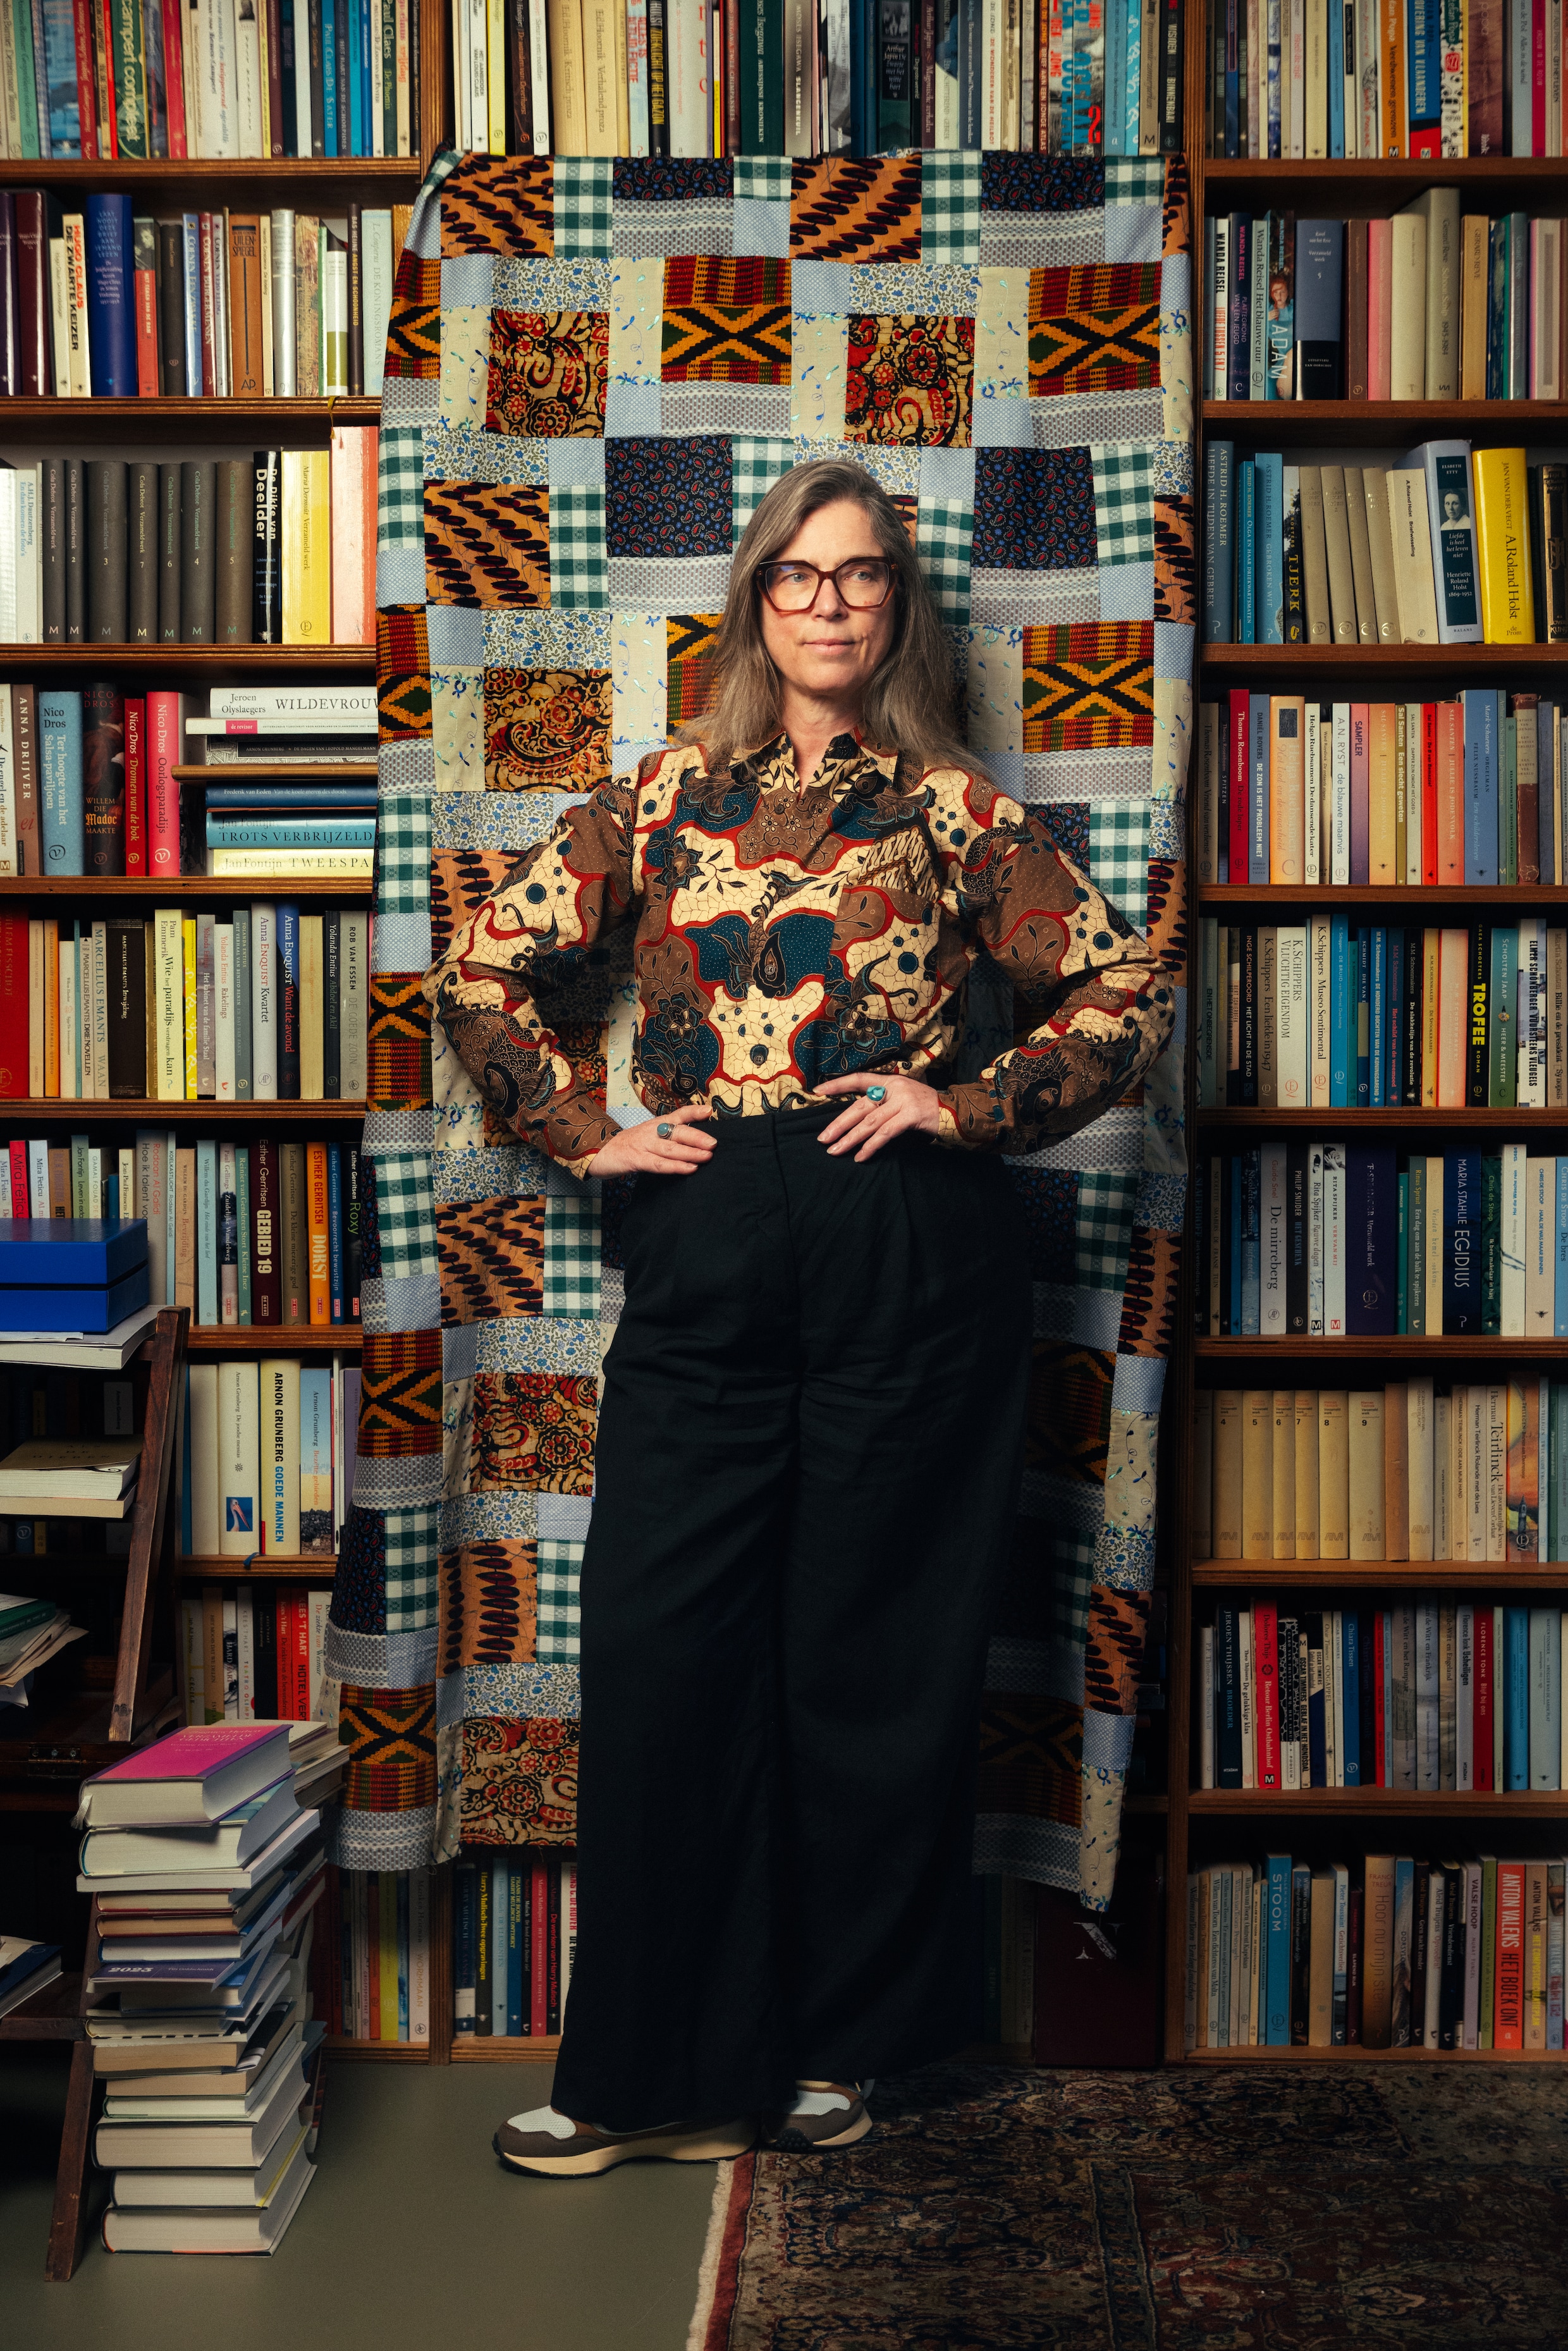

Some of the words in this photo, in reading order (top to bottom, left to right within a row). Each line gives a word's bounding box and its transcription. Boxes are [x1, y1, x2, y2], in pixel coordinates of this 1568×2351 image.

[650, 28, 663, 70] ZOEKLICHT
[651, 71, 663, 82] OP
[651, 83, 664, 97] HET
[121, 66, 140, 141] compleet
[652, 99, 665, 125] GAZON
[1074, 52, 1091, 144] OCEAAN
[66, 226, 73, 242] DE
[73, 225, 82, 261] HUGO
[67, 245, 75, 301] ZWARTE
[75, 266, 83, 309] CLAUS
[352, 276, 358, 284] EN
[70, 305, 78, 350] KEIZER
[1271, 324, 1288, 379] ADAM
[256, 468, 268, 540] Deelder
[1208, 488, 1215, 500] IN
[1220, 490, 1227, 500] H.
[1289, 554, 1300, 611] TJERK
[44, 708, 64, 716] Nico
[221, 704, 266, 715] Olyslaegers
[230, 693, 257, 703] Jeroen
[20, 697, 28, 734] ANNA
[44, 719, 66, 728] Dros
[158, 704, 167, 727] Nico
[57, 735, 66, 751] Ter
[158, 730, 167, 753] Dros
[1337, 742, 1345, 766] RYST
[1354, 721, 1363, 756] SAMPLER
[21, 741, 31, 799] DRIJVER
[44, 735, 54, 809] Salsa-paviljoen
[55, 753, 67, 787] hoogte
[1256, 763, 1263, 771] DE
[1337, 773, 1345, 785] de
[58, 789, 66, 807] van
[156, 758, 168, 834] Oorlogsparadijs
[1337, 787, 1345, 818] blauwe
[58, 809, 68, 825] het
[85, 811, 117, 826] Madoc
[1337, 820, 1345, 854] maanvis
[260, 917, 269, 941] Anna
[164, 957, 174, 976] Wie
[260, 943, 269, 986] ENQUIST
[163, 987, 175, 1026] paradijs
[260, 988, 269, 1023] Kwartet
[1472, 983, 1486, 1045] TROFEE
[166, 1057, 175, 1075] kan
[152, 1143, 161, 1177] Rodaan
[259, 1139, 268, 1165] Esther
[313, 1151, 322, 1179] ESTHER
[153, 1180, 160, 1188] Al
[259, 1167, 269, 1206] Gerritsen
[1457, 1159, 1467, 1188] MARIA
[314, 1182, 324, 1224] GERRITSEN
[1270, 1206, 1282, 1224] De
[1457, 1191, 1467, 1225] STAHLIE
[257, 1210, 272, 1256] GEBIED
[257, 1258, 272, 1274] 19
[312, 1234, 327, 1281] DORST
[1267, 1227, 1282, 1290] mirreberg
[1454, 1230, 1470, 1288] EGIDIUS
[274, 1373, 283, 1406] ARNON
[274, 1409, 283, 1462] GRUNBERG
[1491, 1422, 1503, 1483] Teirlinck
[275, 1466, 283, 1497] GOEDE
[275, 1501, 284, 1542] MANNEN
[1223, 1611, 1232, 1643] JEROEN
[1272, 1874, 1282, 1931] STOOM
[1502, 1873, 1521, 1907] ANTON
[550, 1913, 558, 1923] De
[1501, 1910, 1521, 1948] VALENS
[549, 1962, 558, 1980] Harry
[1501, 1953, 1519, 1973] HET
[1500, 1977, 1519, 2004] BOEK
[1500, 2008, 1518, 2027] ONT
